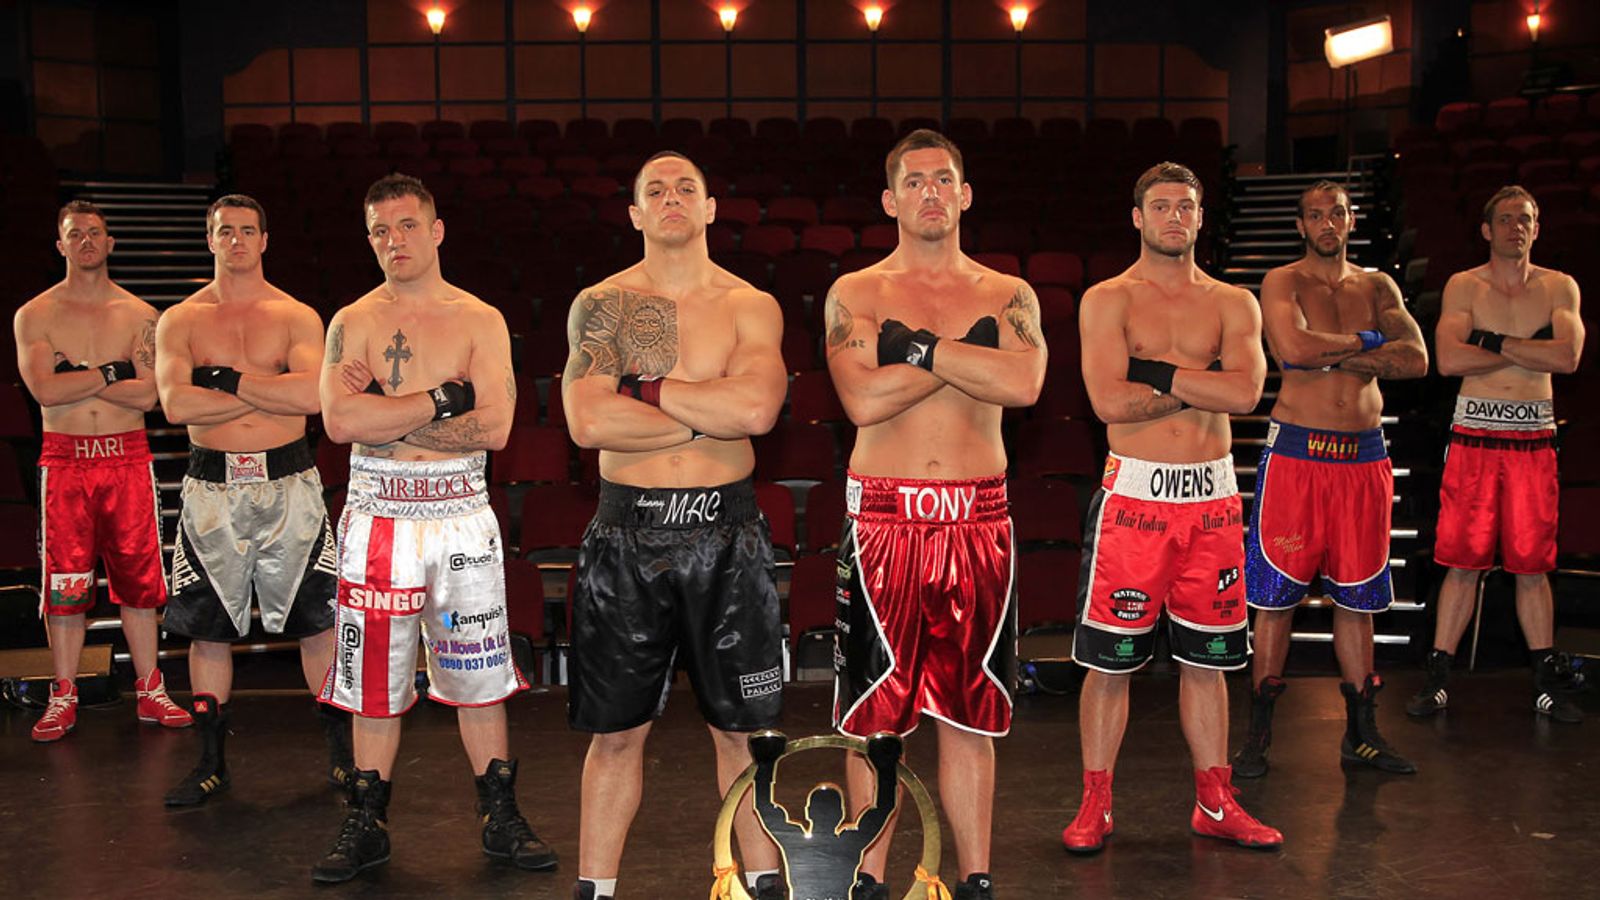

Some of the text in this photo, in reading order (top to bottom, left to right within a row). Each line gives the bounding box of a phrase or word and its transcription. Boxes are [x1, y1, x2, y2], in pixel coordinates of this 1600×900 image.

[1465, 400, 1539, 420] DAWSON
[74, 437, 125, 460] HARI
[1308, 432, 1359, 461] WADI
[378, 473, 475, 498] MR BLOCK
[1150, 467, 1214, 498] OWENS
[662, 490, 721, 524] MAC
[898, 486, 977, 521] TONY
[1217, 568, 1239, 591] AFS
[348, 587, 426, 611] SINGO
[464, 656, 485, 671] 037
